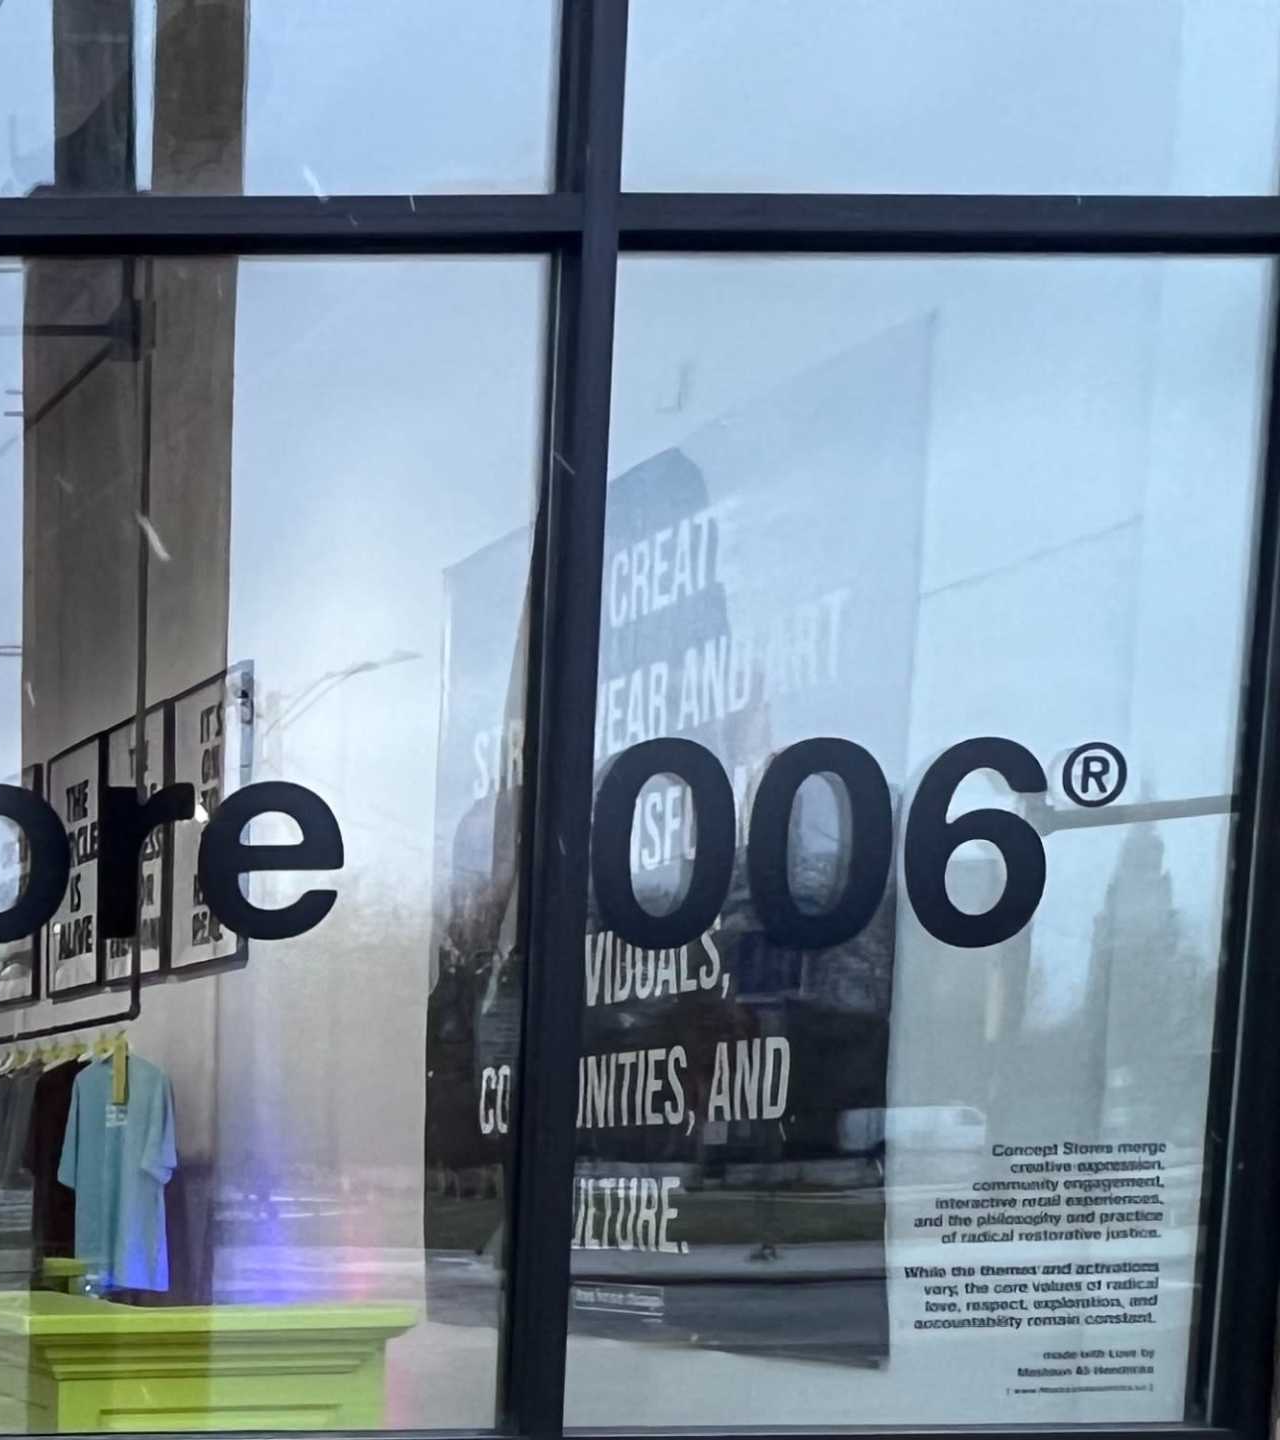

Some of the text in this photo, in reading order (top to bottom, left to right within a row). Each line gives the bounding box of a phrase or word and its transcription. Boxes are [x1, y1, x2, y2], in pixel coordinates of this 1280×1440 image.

[65, 779, 90, 823] THE
[707, 1036, 791, 1123] AND
[991, 1141, 1167, 1158] Concept Stores merge
[1010, 1161, 1072, 1174] creative
[972, 1179, 1059, 1192] community
[935, 1197, 1017, 1210] interactive
[913, 1210, 1164, 1228] and the philosophy and practice
[941, 1231, 957, 1245] of
[960, 1229, 1014, 1243] radical
[1018, 1229, 1102, 1241] restorative
[904, 1261, 1160, 1279] While the themes and activations
[963, 1282, 990, 1295] the
[993, 1283, 1029, 1294] core
[1086, 1279, 1102, 1291] of
[1105, 1277, 1159, 1291] radical
[1129, 1294, 1159, 1308] and
[913, 1312, 1157, 1331] accountability remain constant.
